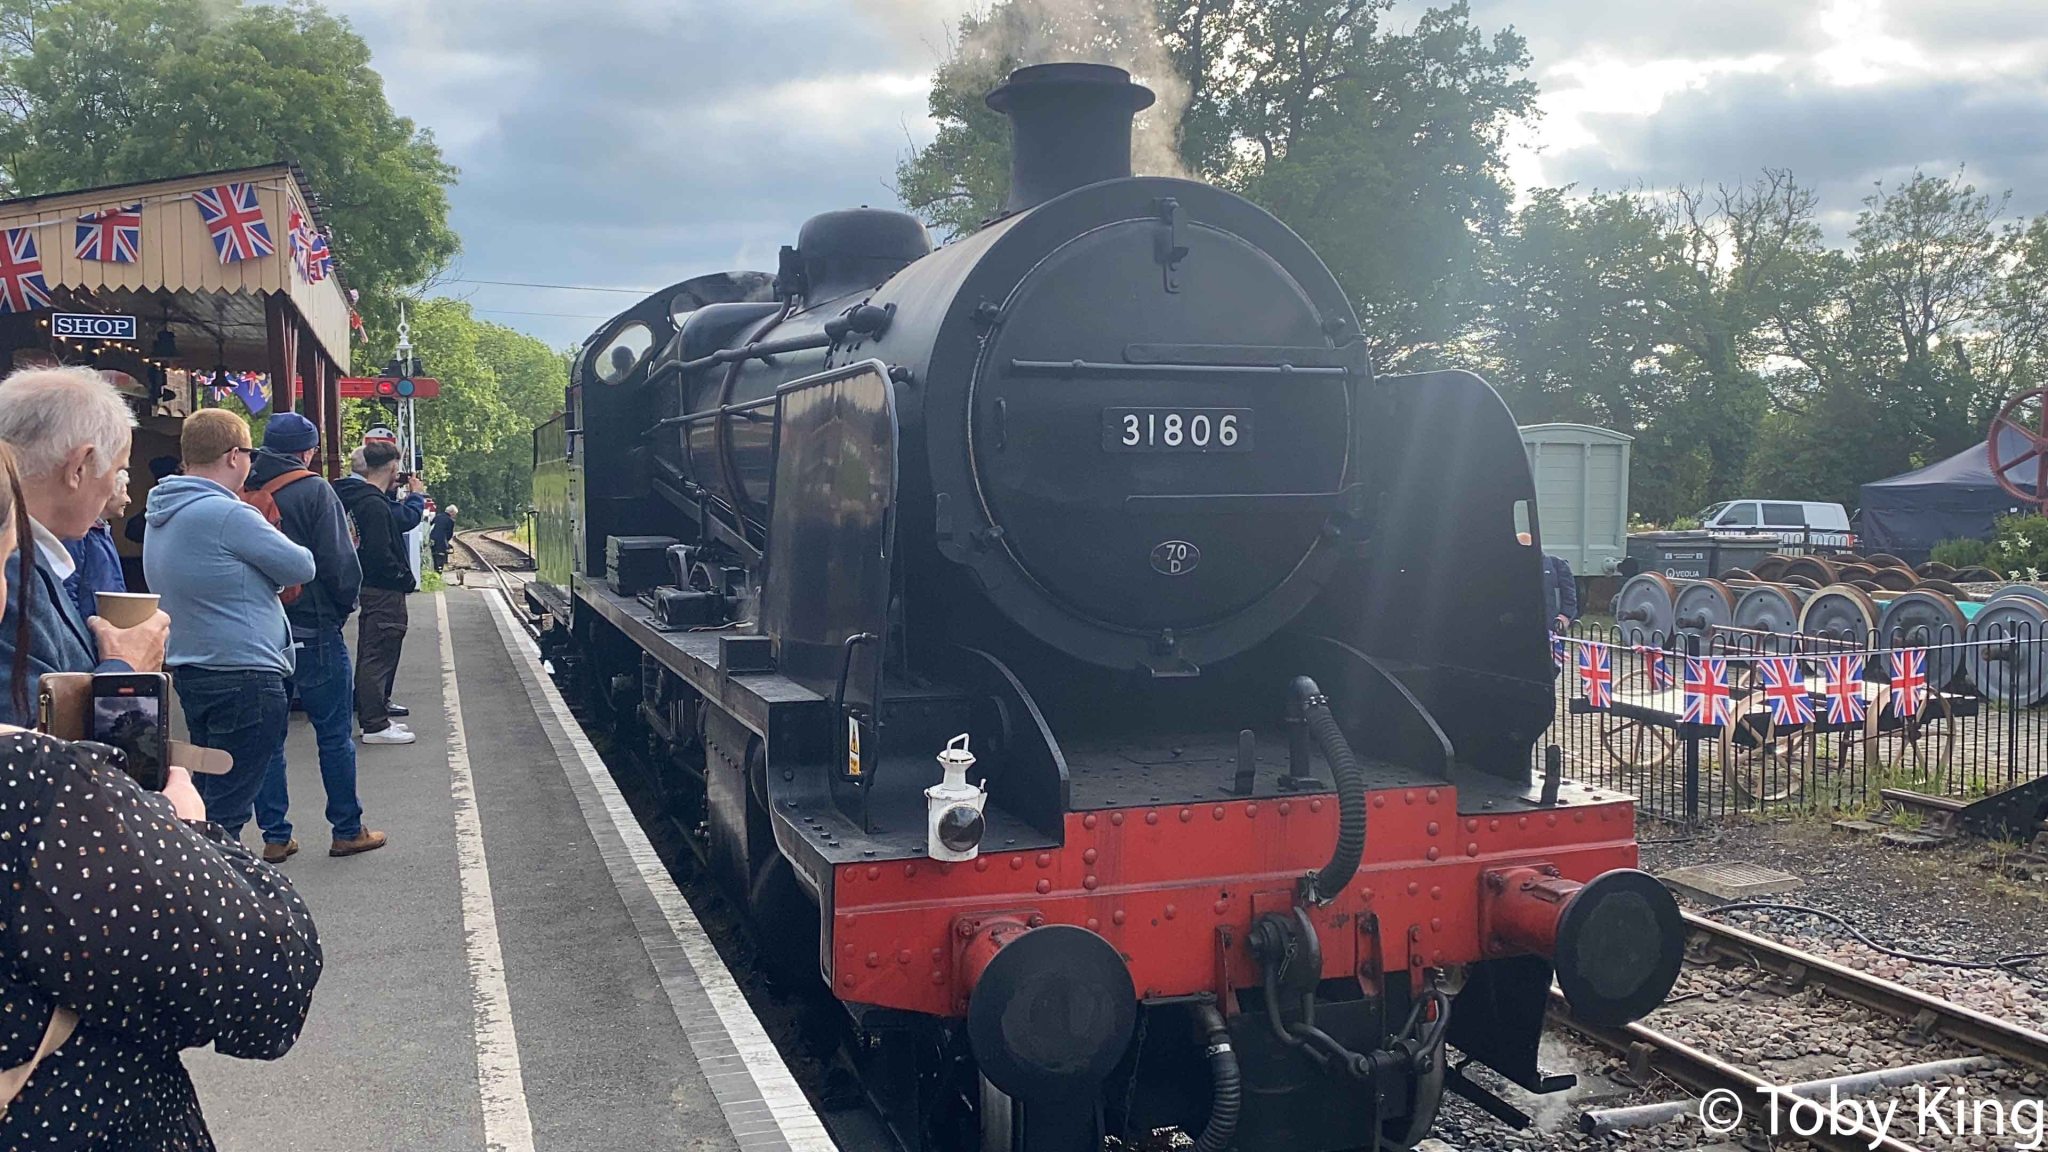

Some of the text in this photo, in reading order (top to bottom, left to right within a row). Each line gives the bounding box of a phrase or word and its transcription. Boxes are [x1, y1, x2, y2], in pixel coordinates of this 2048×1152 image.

[57, 318, 129, 335] SHOP
[1122, 414, 1238, 447] 31806
[1166, 545, 1187, 560] 70
[1170, 560, 1181, 572] D
